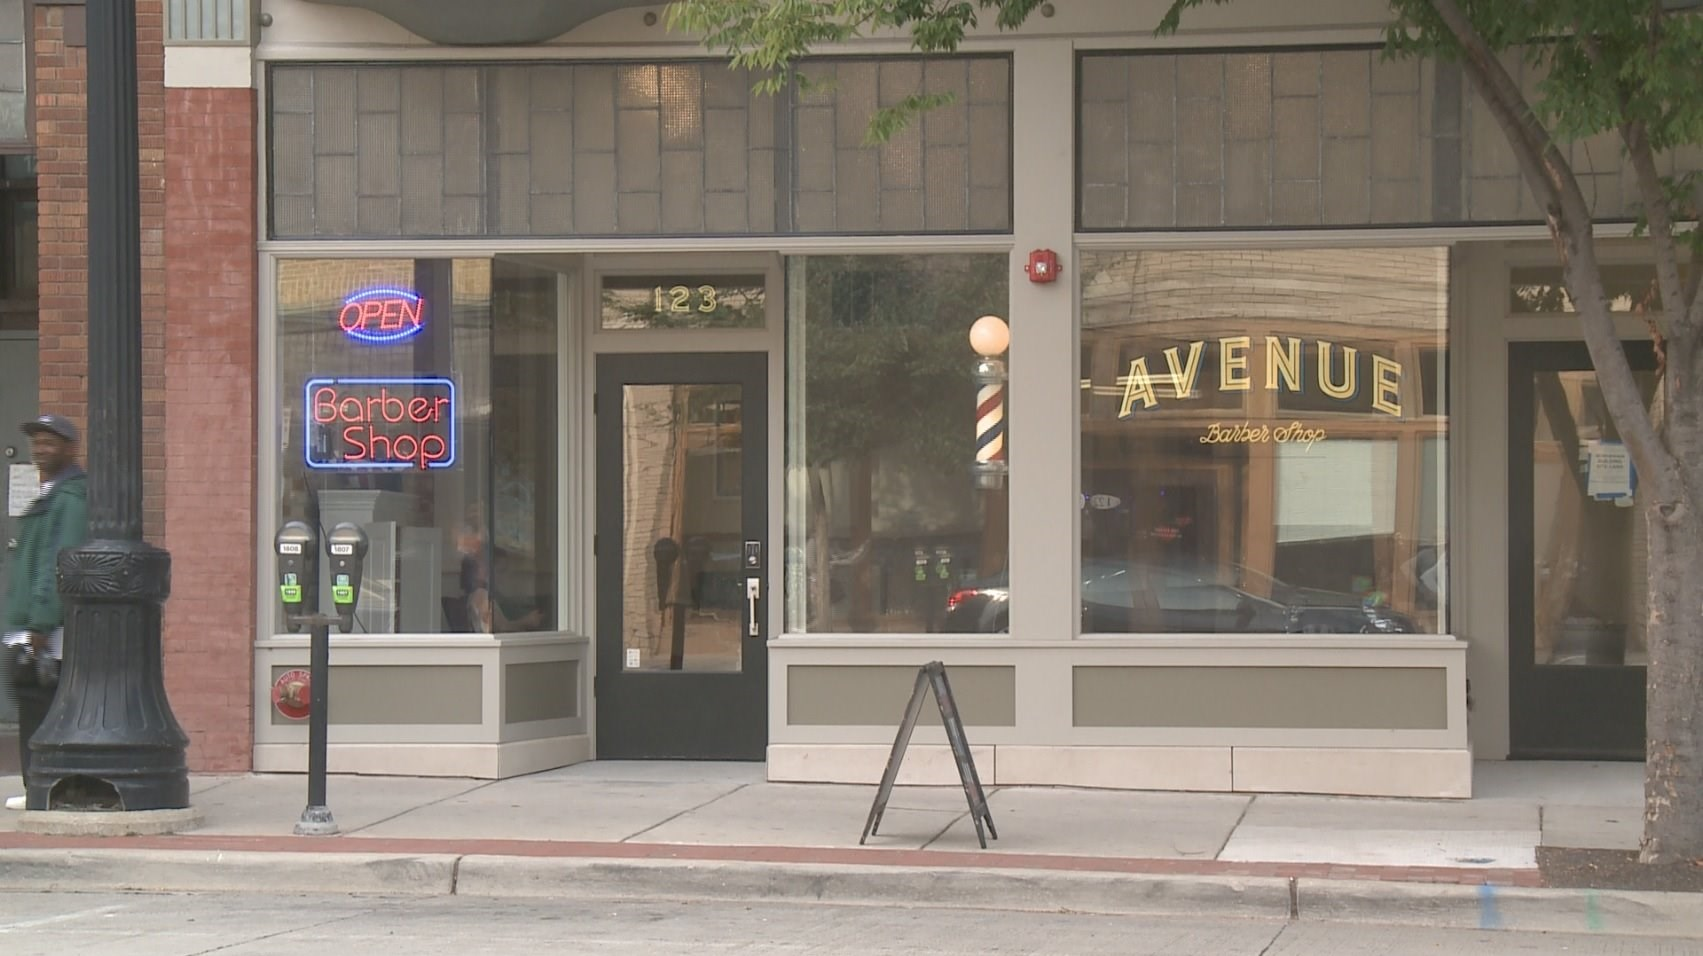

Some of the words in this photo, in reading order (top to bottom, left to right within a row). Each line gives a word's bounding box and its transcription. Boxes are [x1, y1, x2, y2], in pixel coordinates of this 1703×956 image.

[338, 298, 424, 331] OPEN
[654, 284, 717, 313] 123
[1117, 334, 1404, 419] AVENUE
[314, 387, 451, 424] Barber
[342, 425, 446, 470] Shop
[1199, 421, 1270, 444] Barber
[1273, 421, 1327, 453] Shop
